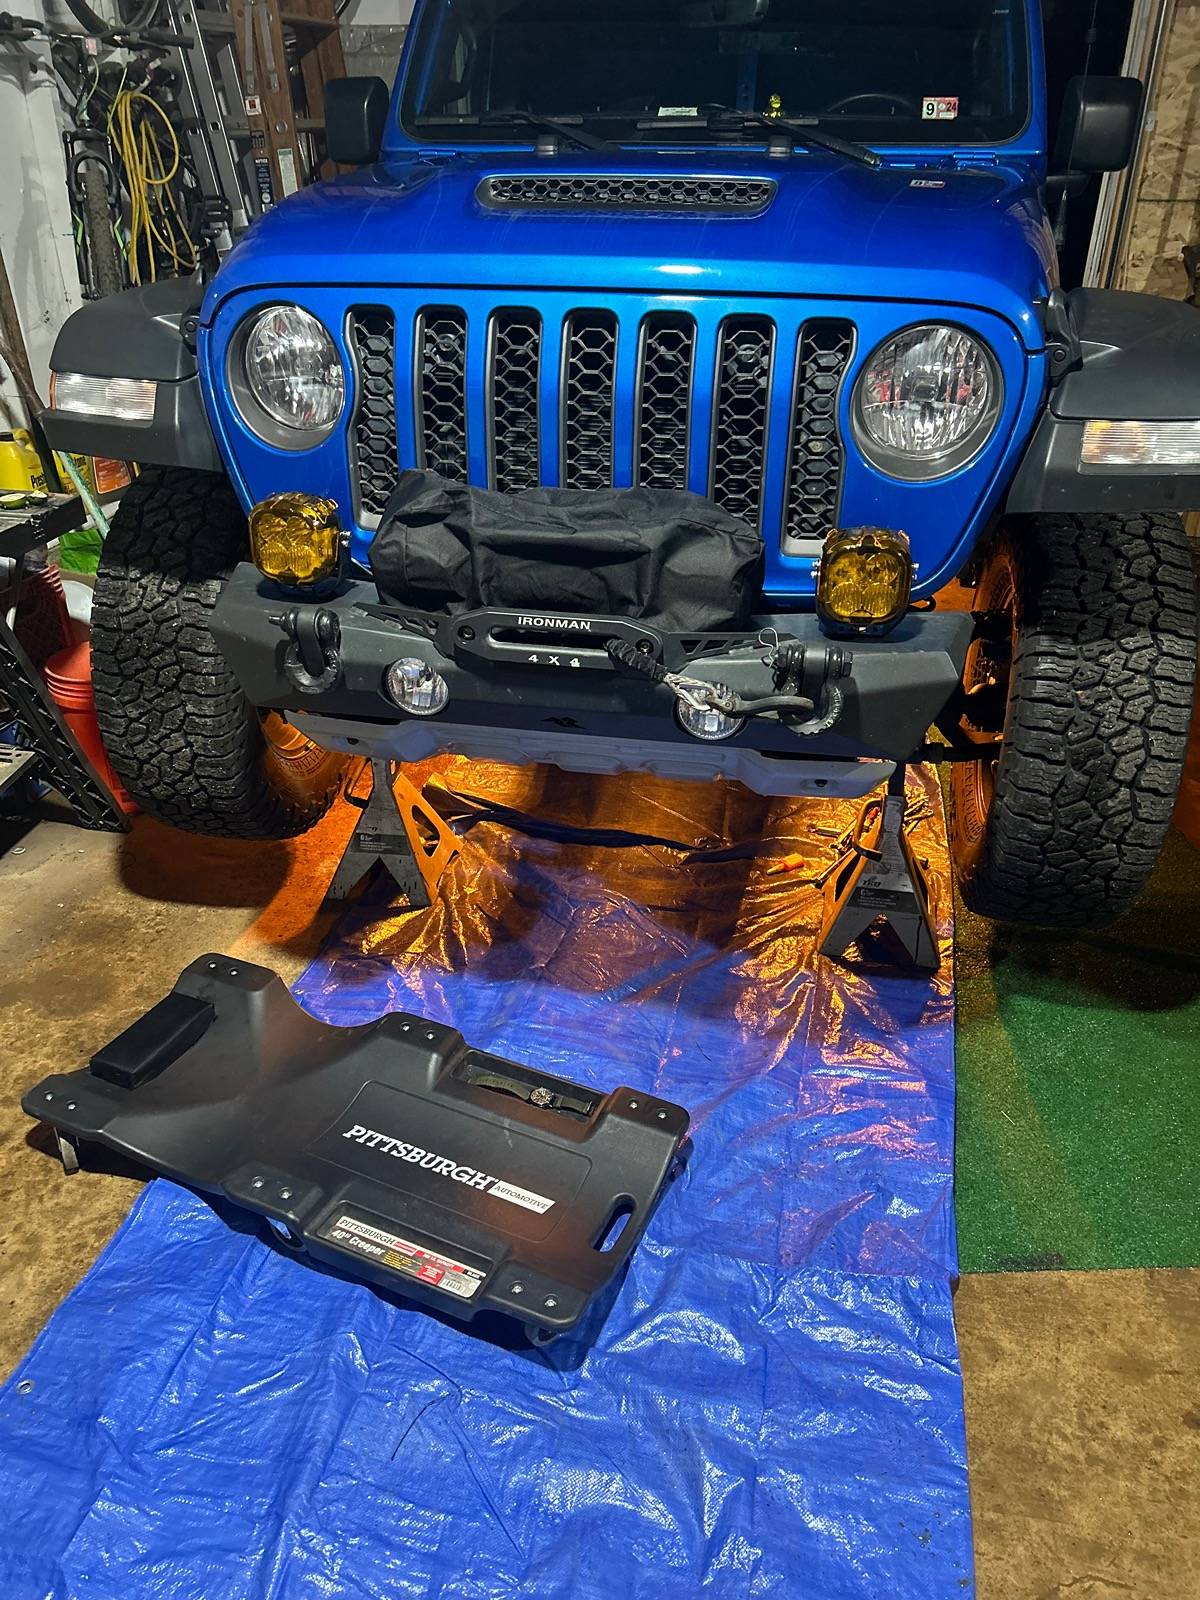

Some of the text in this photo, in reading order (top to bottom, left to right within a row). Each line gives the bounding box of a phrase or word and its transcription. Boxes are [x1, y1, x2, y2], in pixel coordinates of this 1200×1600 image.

[926, 102, 957, 116] 9 24
[517, 616, 591, 630] IRONMAN
[528, 654, 581, 667] 4 X 4
[342, 1124, 549, 1209] PITTSBURGH AUTOMOTIVE
[340, 1220, 396, 1245] PITTSBURGH
[348, 1236, 386, 1256] Creeper
